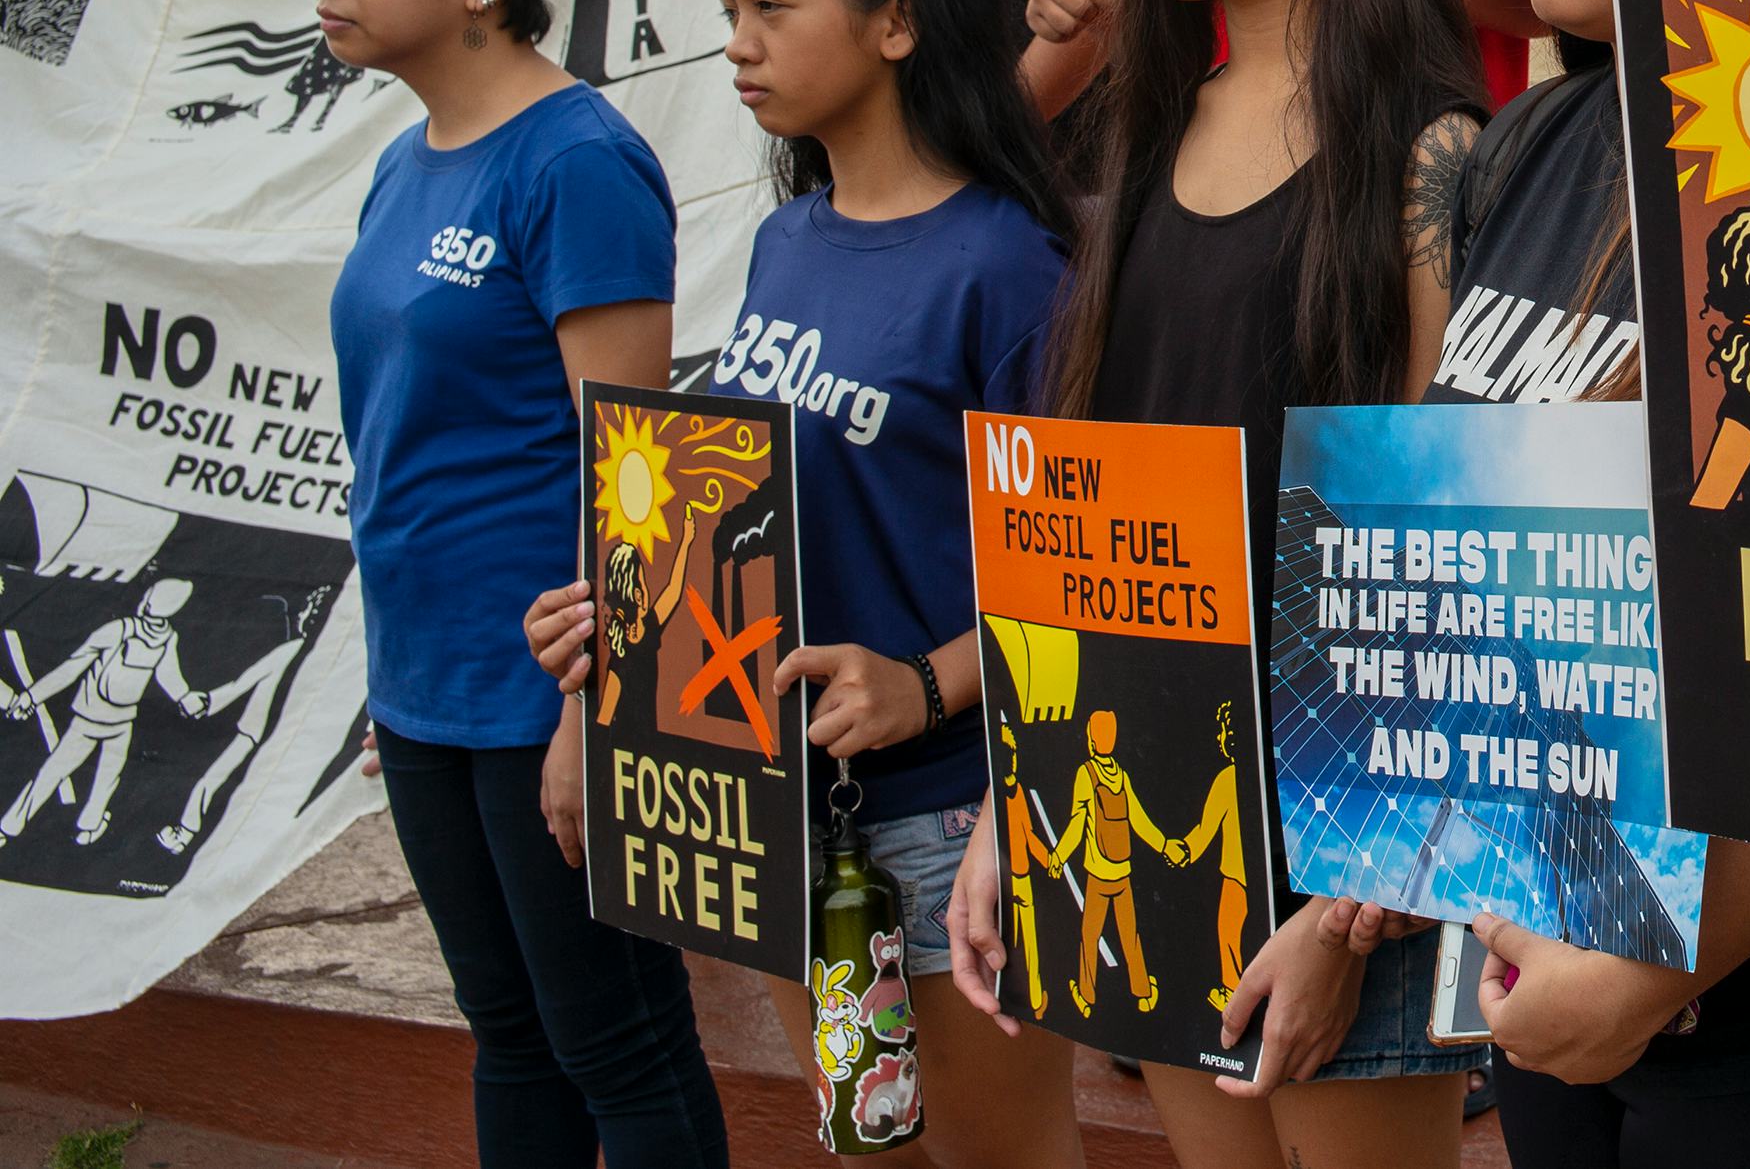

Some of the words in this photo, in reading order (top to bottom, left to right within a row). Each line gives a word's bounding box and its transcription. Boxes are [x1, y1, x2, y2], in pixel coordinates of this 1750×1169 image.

[431, 225, 497, 271] 350
[100, 301, 217, 389] NO
[228, 362, 323, 413] NEW
[714, 313, 892, 447] 350.org
[109, 392, 235, 449] FOSSIL
[251, 420, 343, 466] FUEL
[985, 422, 1035, 496] NO
[1044, 454, 1101, 503] NEW
[164, 452, 352, 516] PROJECTS
[1004, 507, 1094, 560] FOSSIL
[1110, 518, 1191, 569] FUEL
[1315, 527, 1395, 581] THE
[1405, 529, 1517, 585] BEST
[1527, 532, 1653, 592] THING
[1063, 572, 1219, 630] PROJECTS
[1318, 587, 1351, 630] IN
[1358, 589, 1428, 634] LIFE
[1436, 592, 1506, 638] ARE
[1514, 596, 1595, 644] FREE
[1602, 601, 1658, 649] LIK
[1329, 646, 1405, 698] THE
[1414, 651, 1527, 714] WIND,
[1536, 659, 1658, 721] WATER
[1367, 727, 1451, 780] AND
[1460, 733, 1539, 790] THE
[1548, 742, 1619, 802] SUN
[613, 748, 766, 856] FOSSIL
[625, 833, 759, 942] FREE
[1200, 1052, 1245, 1072] PAPERHAND
